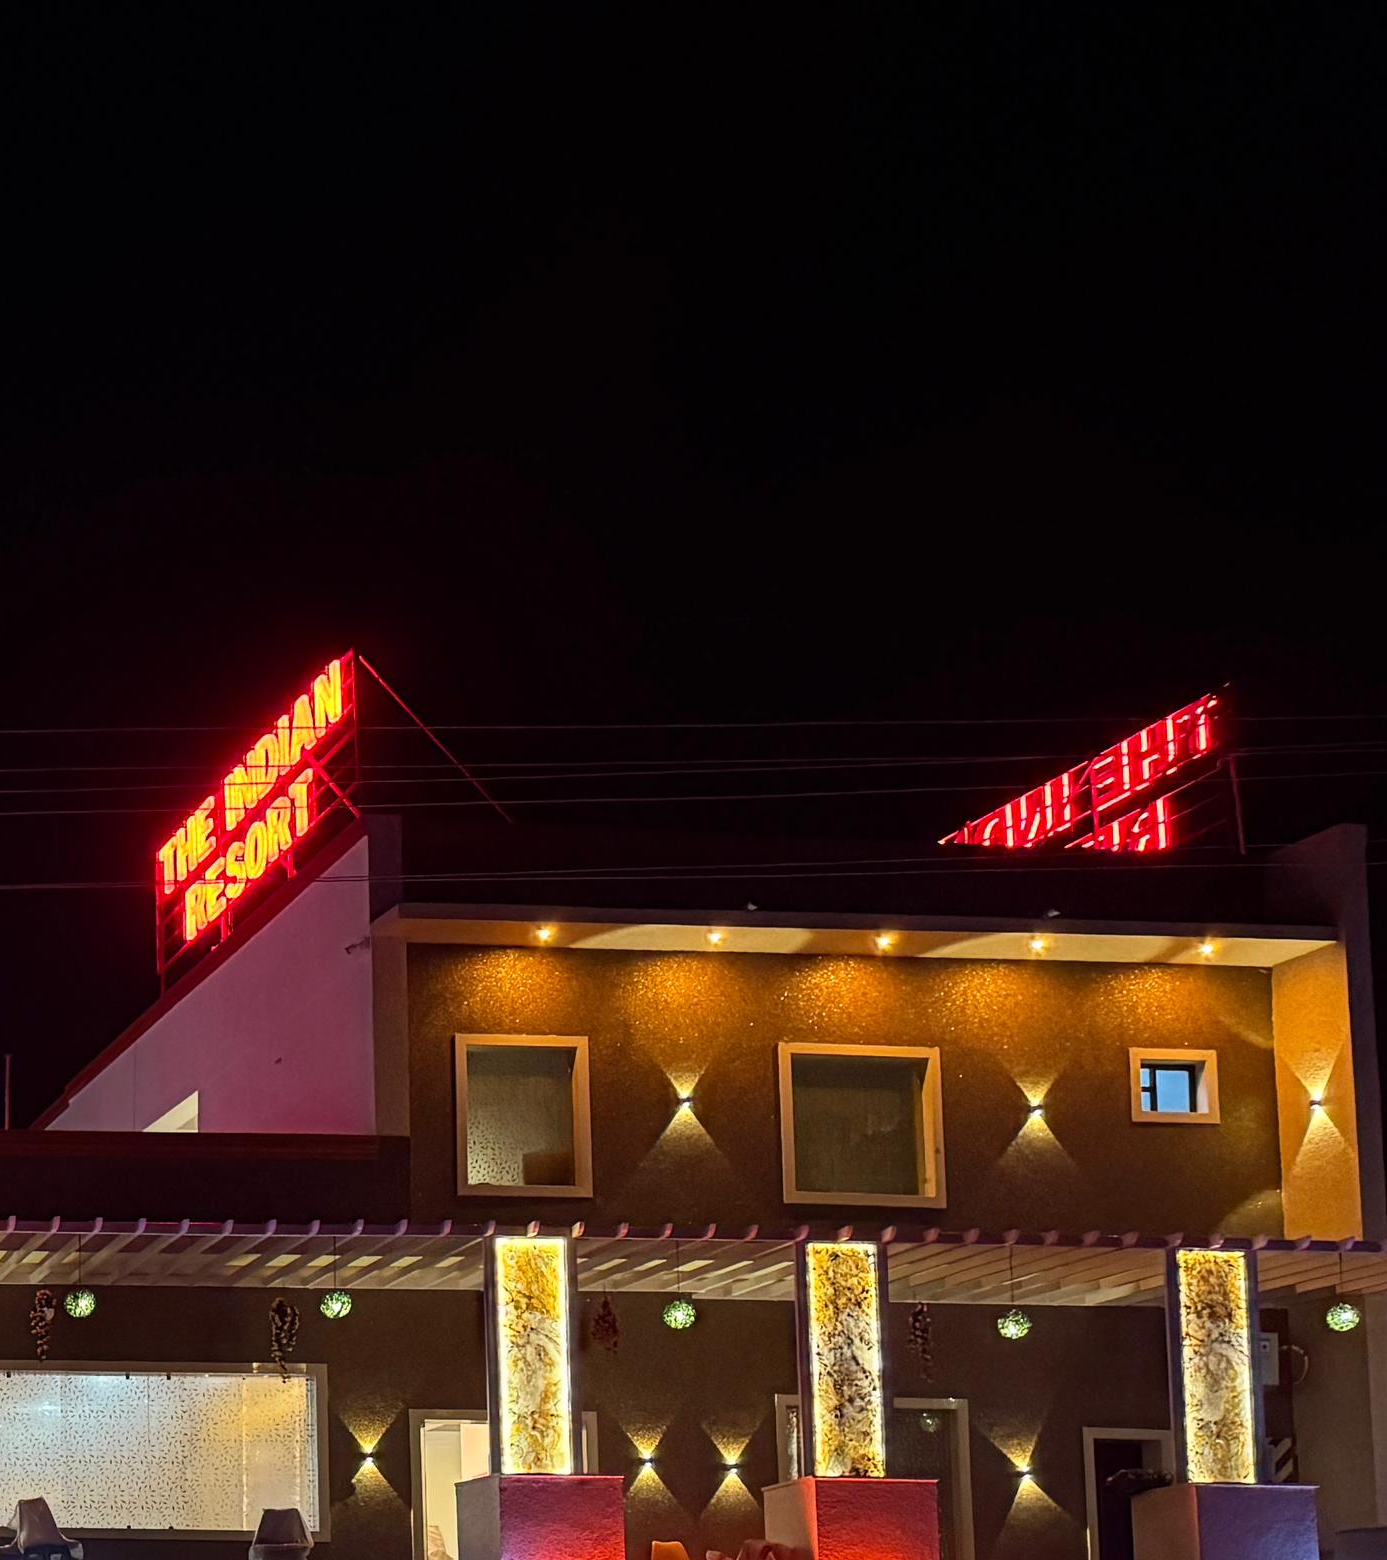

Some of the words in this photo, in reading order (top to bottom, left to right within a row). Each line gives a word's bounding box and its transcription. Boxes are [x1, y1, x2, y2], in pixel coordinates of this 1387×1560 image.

[158, 795, 217, 894] THE
[223, 659, 342, 831] INDIAN
[184, 767, 313, 941] RESORT
